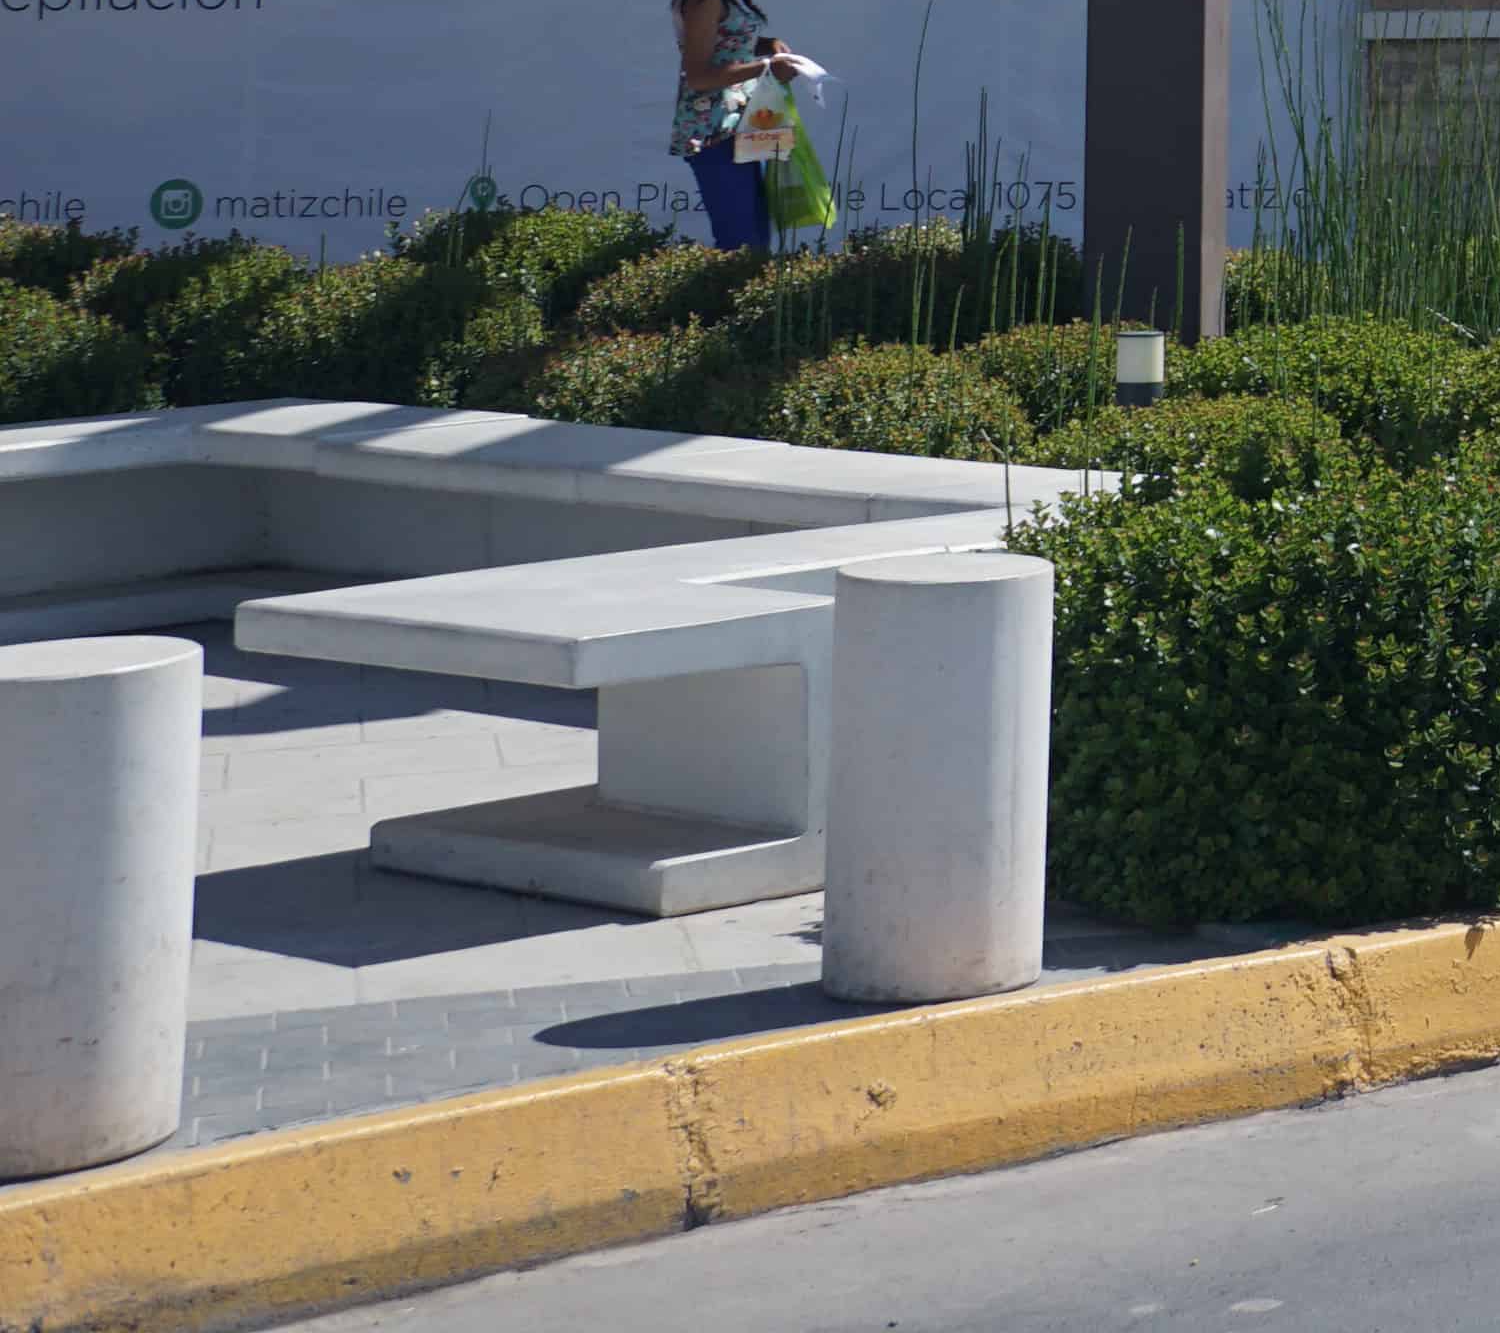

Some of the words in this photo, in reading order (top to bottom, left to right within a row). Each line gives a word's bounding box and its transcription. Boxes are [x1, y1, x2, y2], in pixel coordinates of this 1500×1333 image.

[215, 187, 408, 218] matizchile
[636, 182, 708, 212] Plaz
[880, 183, 972, 212] Loca
[994, 181, 1077, 211] 1075
